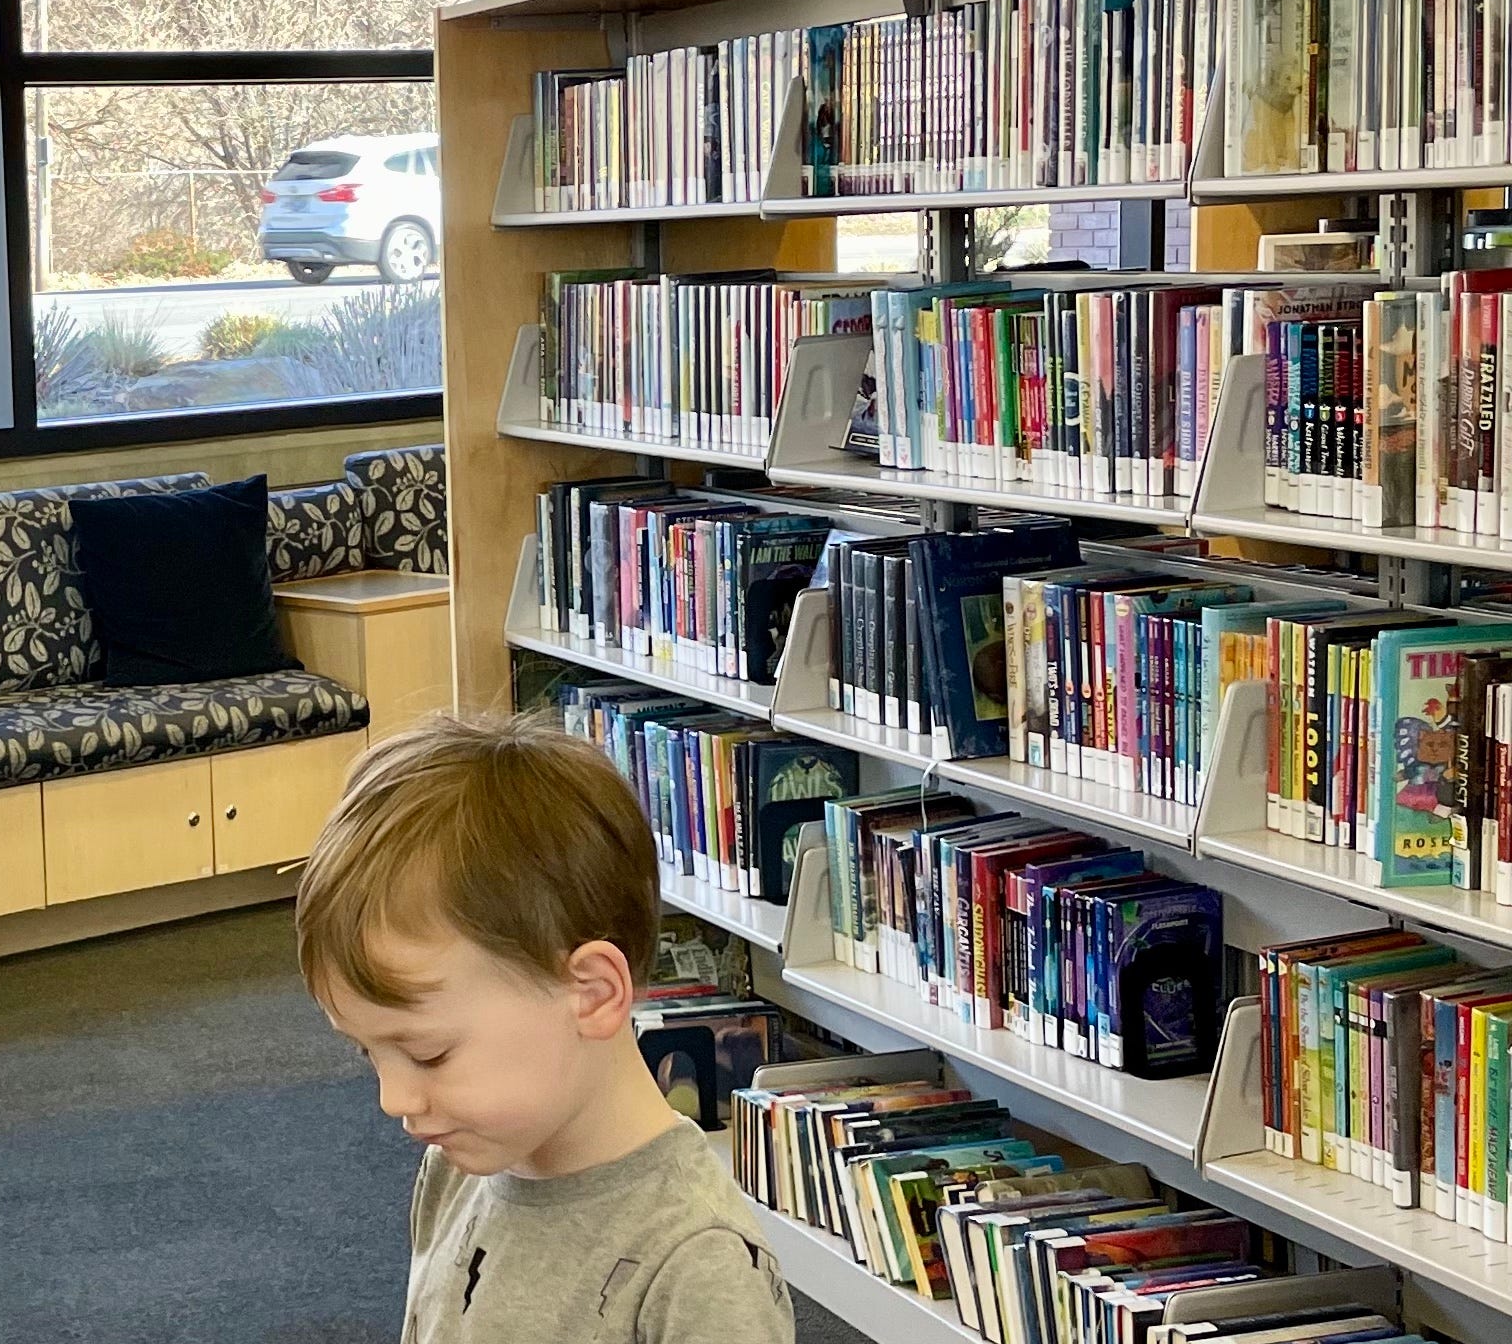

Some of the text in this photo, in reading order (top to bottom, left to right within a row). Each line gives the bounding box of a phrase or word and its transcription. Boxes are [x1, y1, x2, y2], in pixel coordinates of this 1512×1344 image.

[1277, 302, 1333, 316] JONATHAN
[1181, 371, 1192, 416] BALLET
[1479, 353, 1495, 431] FRAZZLED
[756, 547, 772, 564] AM
[773, 545, 793, 563] THE
[1308, 637, 1316, 698] WATSON
[1306, 712, 1320, 785] LOOT
